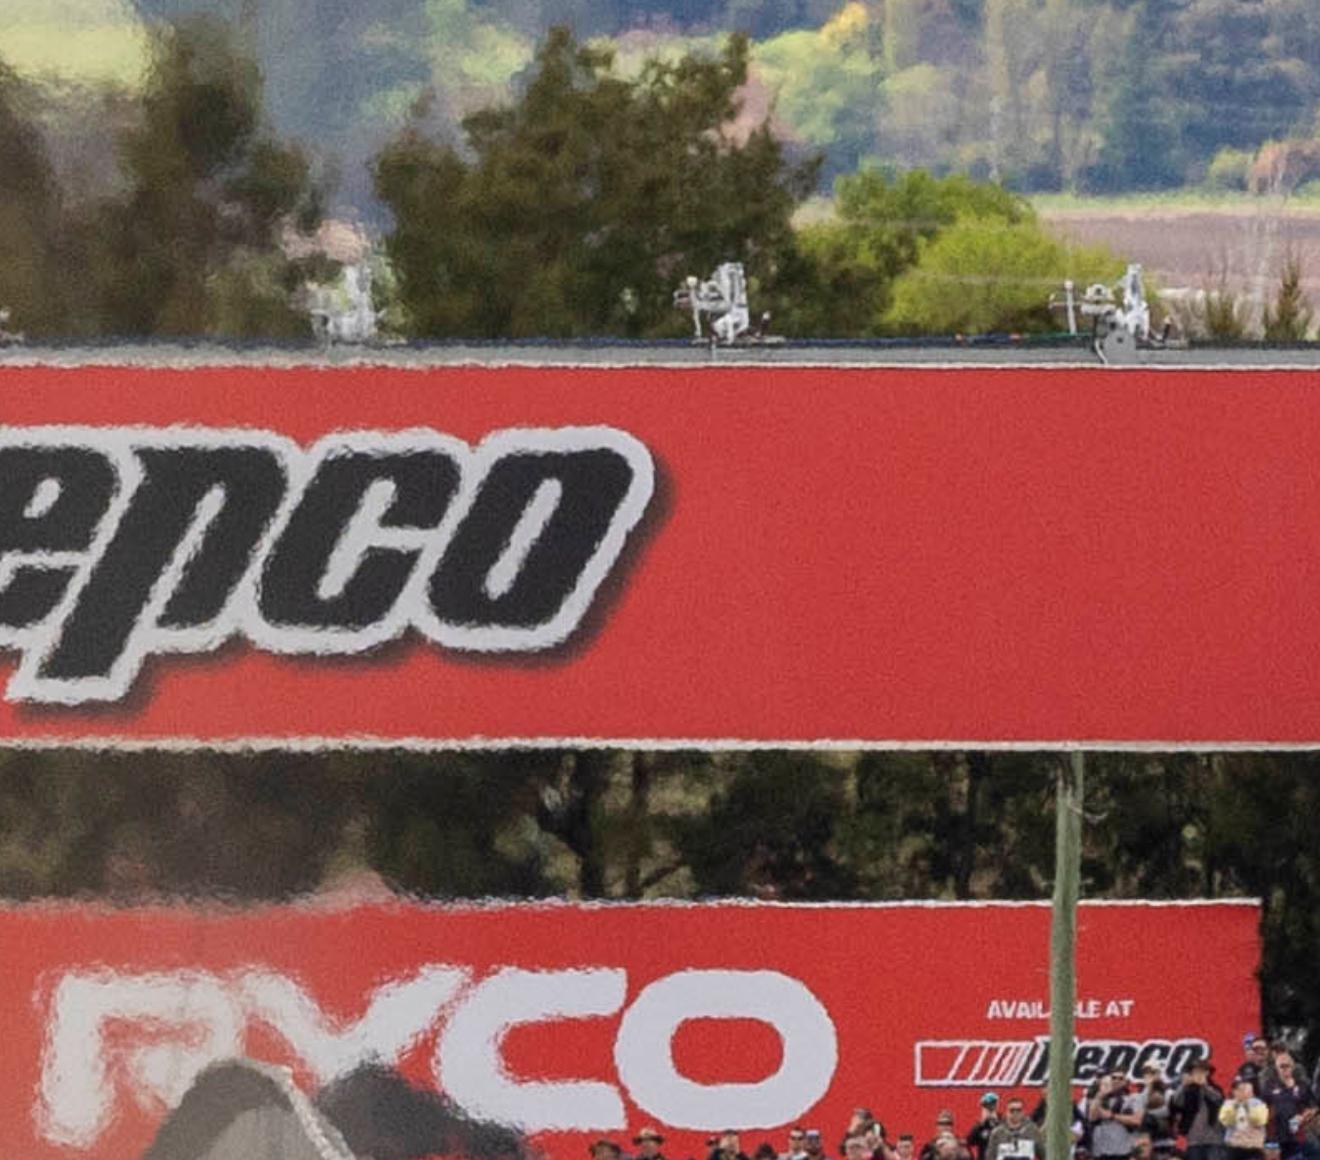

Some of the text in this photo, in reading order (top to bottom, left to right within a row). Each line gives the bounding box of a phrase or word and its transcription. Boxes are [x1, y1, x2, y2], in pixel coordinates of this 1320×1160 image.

[36, 965, 838, 1146] RYCO
[987, 1000, 1135, 1019] AVAILLE AT
